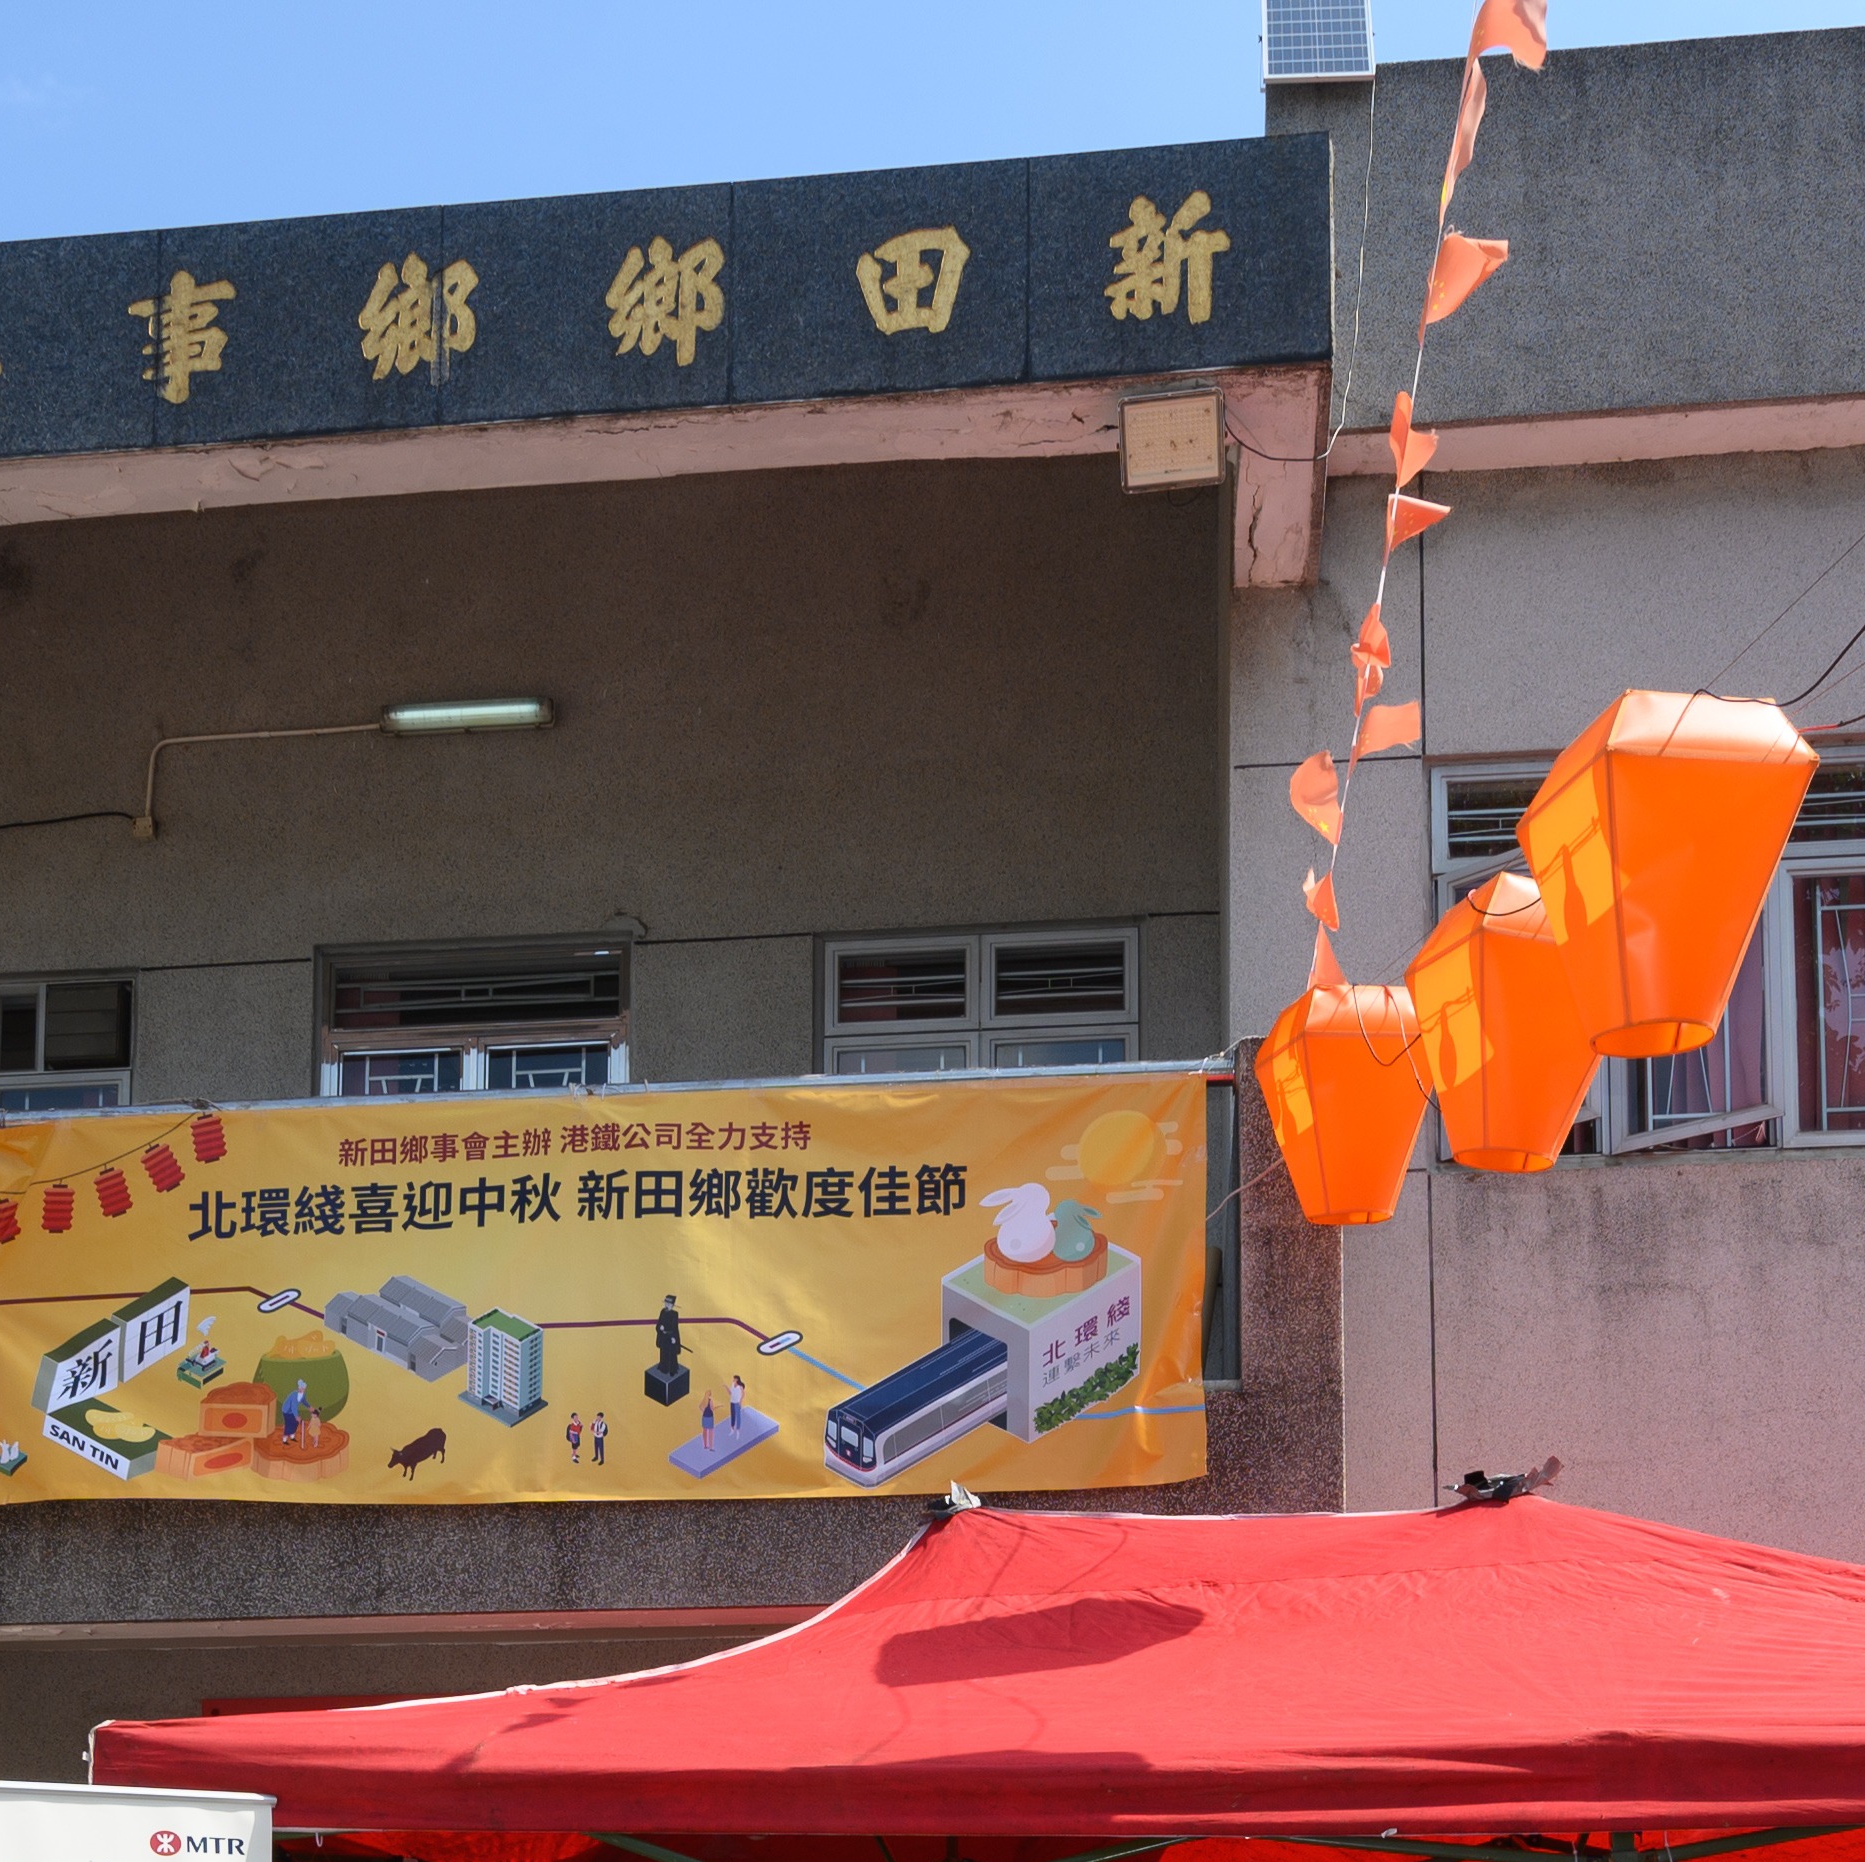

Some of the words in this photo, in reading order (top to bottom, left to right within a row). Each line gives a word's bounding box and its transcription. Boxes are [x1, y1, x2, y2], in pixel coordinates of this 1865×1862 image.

[337, 1127, 552, 1168] 新田鄉事會主辦
[559, 1121, 812, 1154] 港鐵公司全力支持
[187, 1173, 562, 1242] 北環綫喜迎中秋
[577, 1163, 967, 1221] 新田鄉歡度佳節
[57, 1300, 183, 1400] 新田
[1041, 1296, 1130, 1368] 北環綫
[1041, 1328, 1121, 1388] 連繫未來
[49, 1424, 86, 1453] SAN
[88, 1446, 120, 1471] TIN
[185, 1835, 245, 1856] MTR
